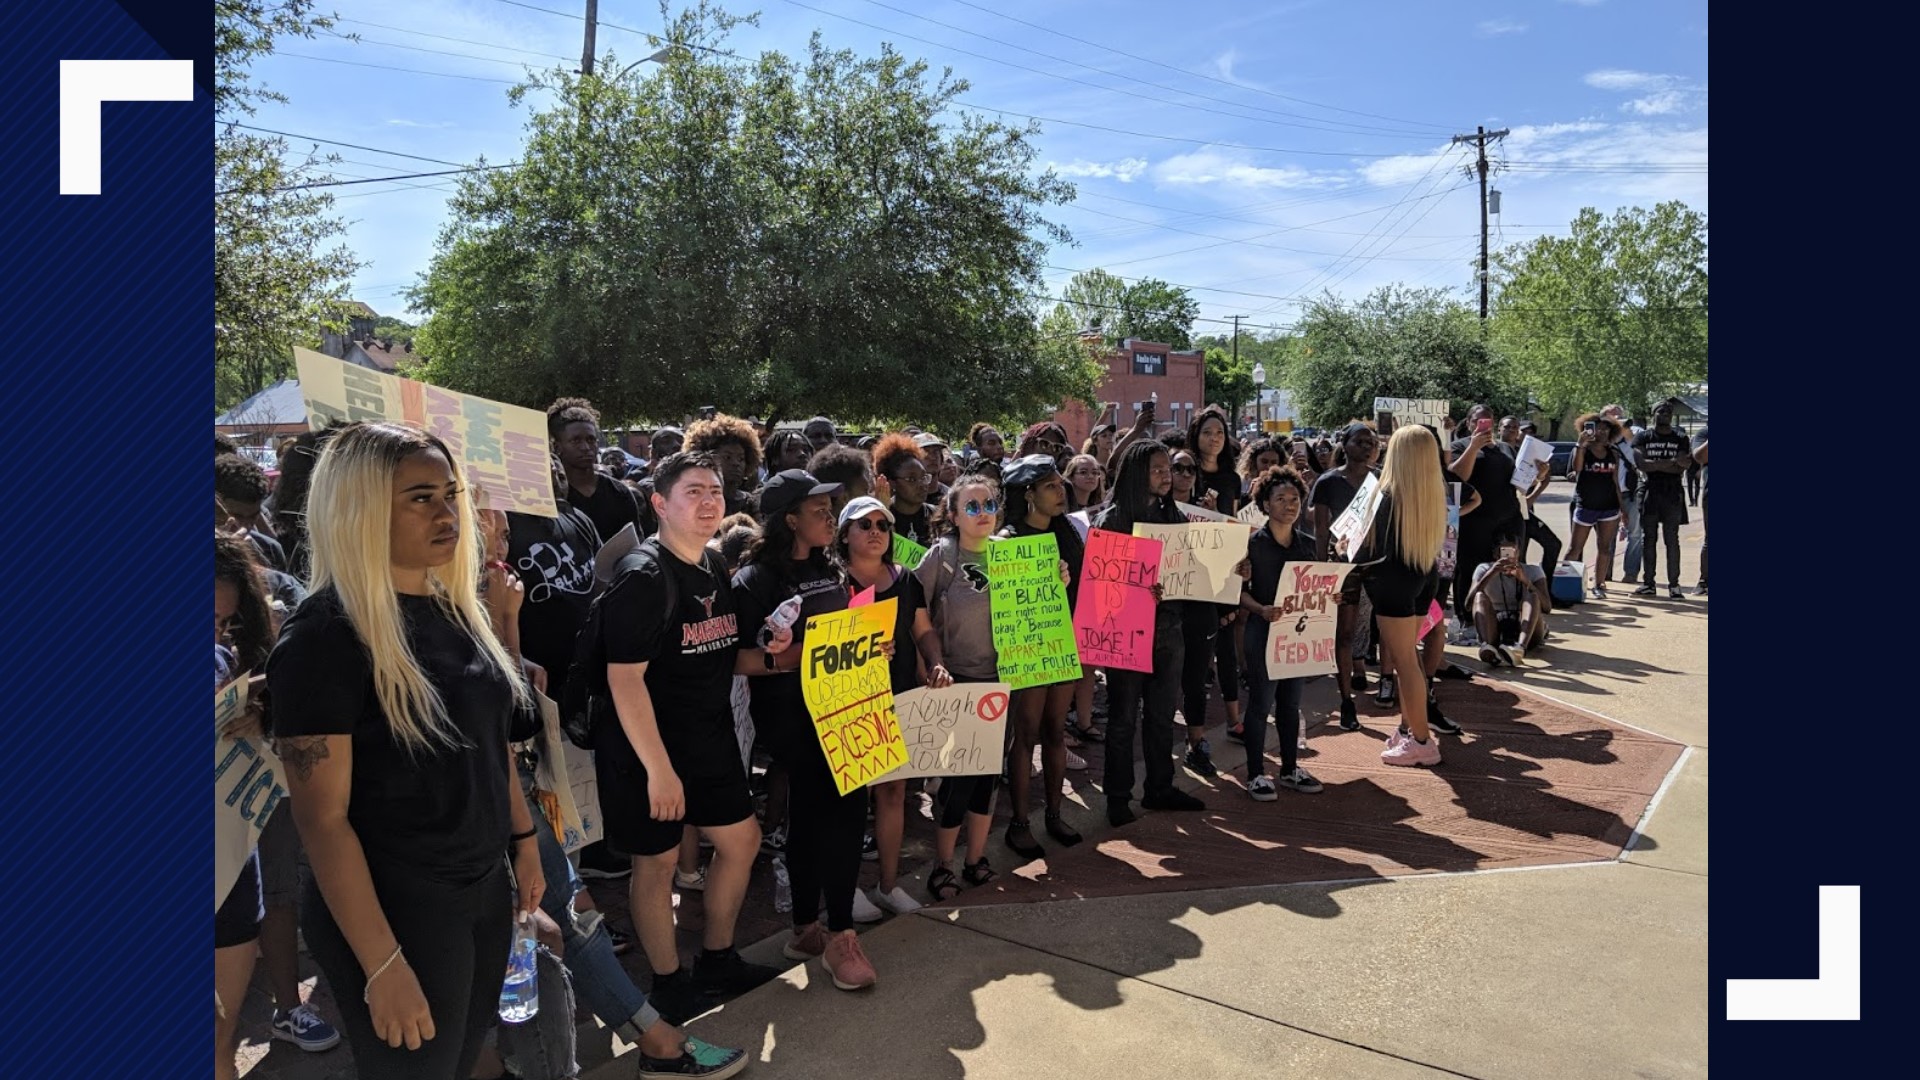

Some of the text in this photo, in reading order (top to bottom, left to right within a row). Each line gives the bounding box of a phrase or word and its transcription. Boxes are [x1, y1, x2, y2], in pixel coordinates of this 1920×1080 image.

[1407, 399, 1449, 415] POLICE
[1175, 529, 1207, 550] SKIN
[1210, 528, 1224, 550] IS
[1015, 545, 1035, 559] ALL
[1164, 551, 1196, 570] NOT A
[990, 558, 1054, 577] MATTER BUT
[1088, 555, 1157, 587] SYSTEM
[1020, 572, 1053, 587] focused
[1161, 570, 1196, 596] RIME
[1000, 584, 1061, 605] on BLACK
[1105, 583, 1122, 608] IS
[1283, 591, 1327, 614] BLACK
[1016, 606, 1037, 620] right
[1041, 604, 1062, 614] now
[1102, 611, 1116, 629] A
[1009, 633, 1016, 645] is
[1023, 633, 1043, 645] very
[1273, 635, 1308, 664] FED
[810, 630, 885, 679] FORCE
[998, 653, 1078, 675] that our POLICE
[1056, 667, 1076, 678] THAT
[808, 674, 852, 706] USED
